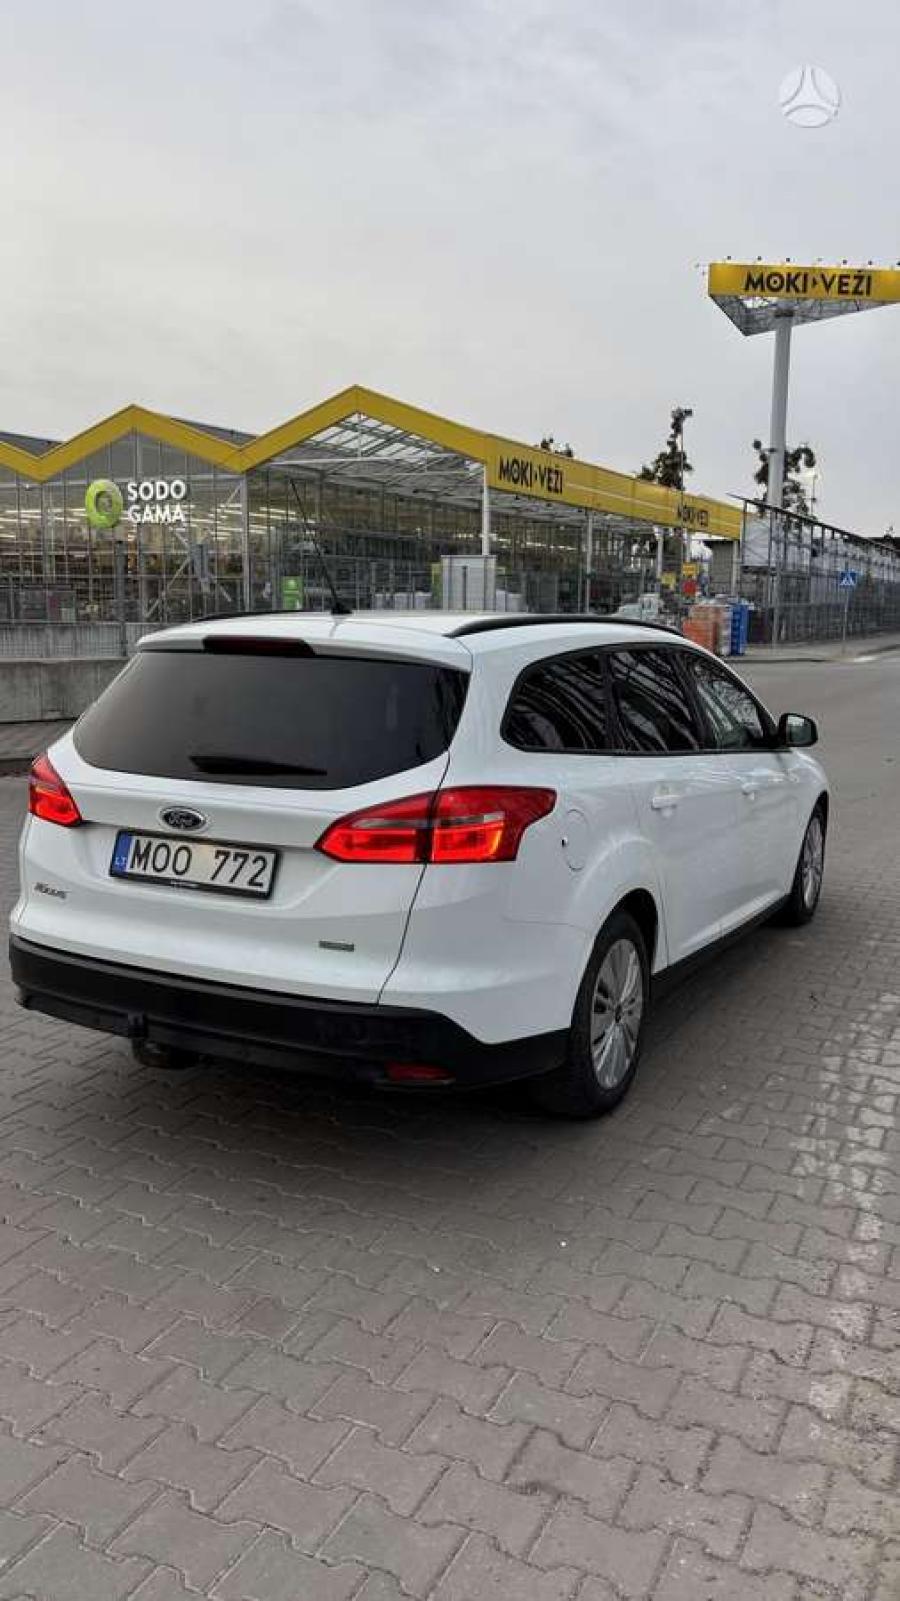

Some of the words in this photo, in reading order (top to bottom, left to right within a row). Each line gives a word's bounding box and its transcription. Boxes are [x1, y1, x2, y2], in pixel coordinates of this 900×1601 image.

[127, 480, 187, 501] SODO
[127, 504, 186, 524] GAMA
[130, 839, 193, 876] MOO
[210, 849, 269, 889] 772
